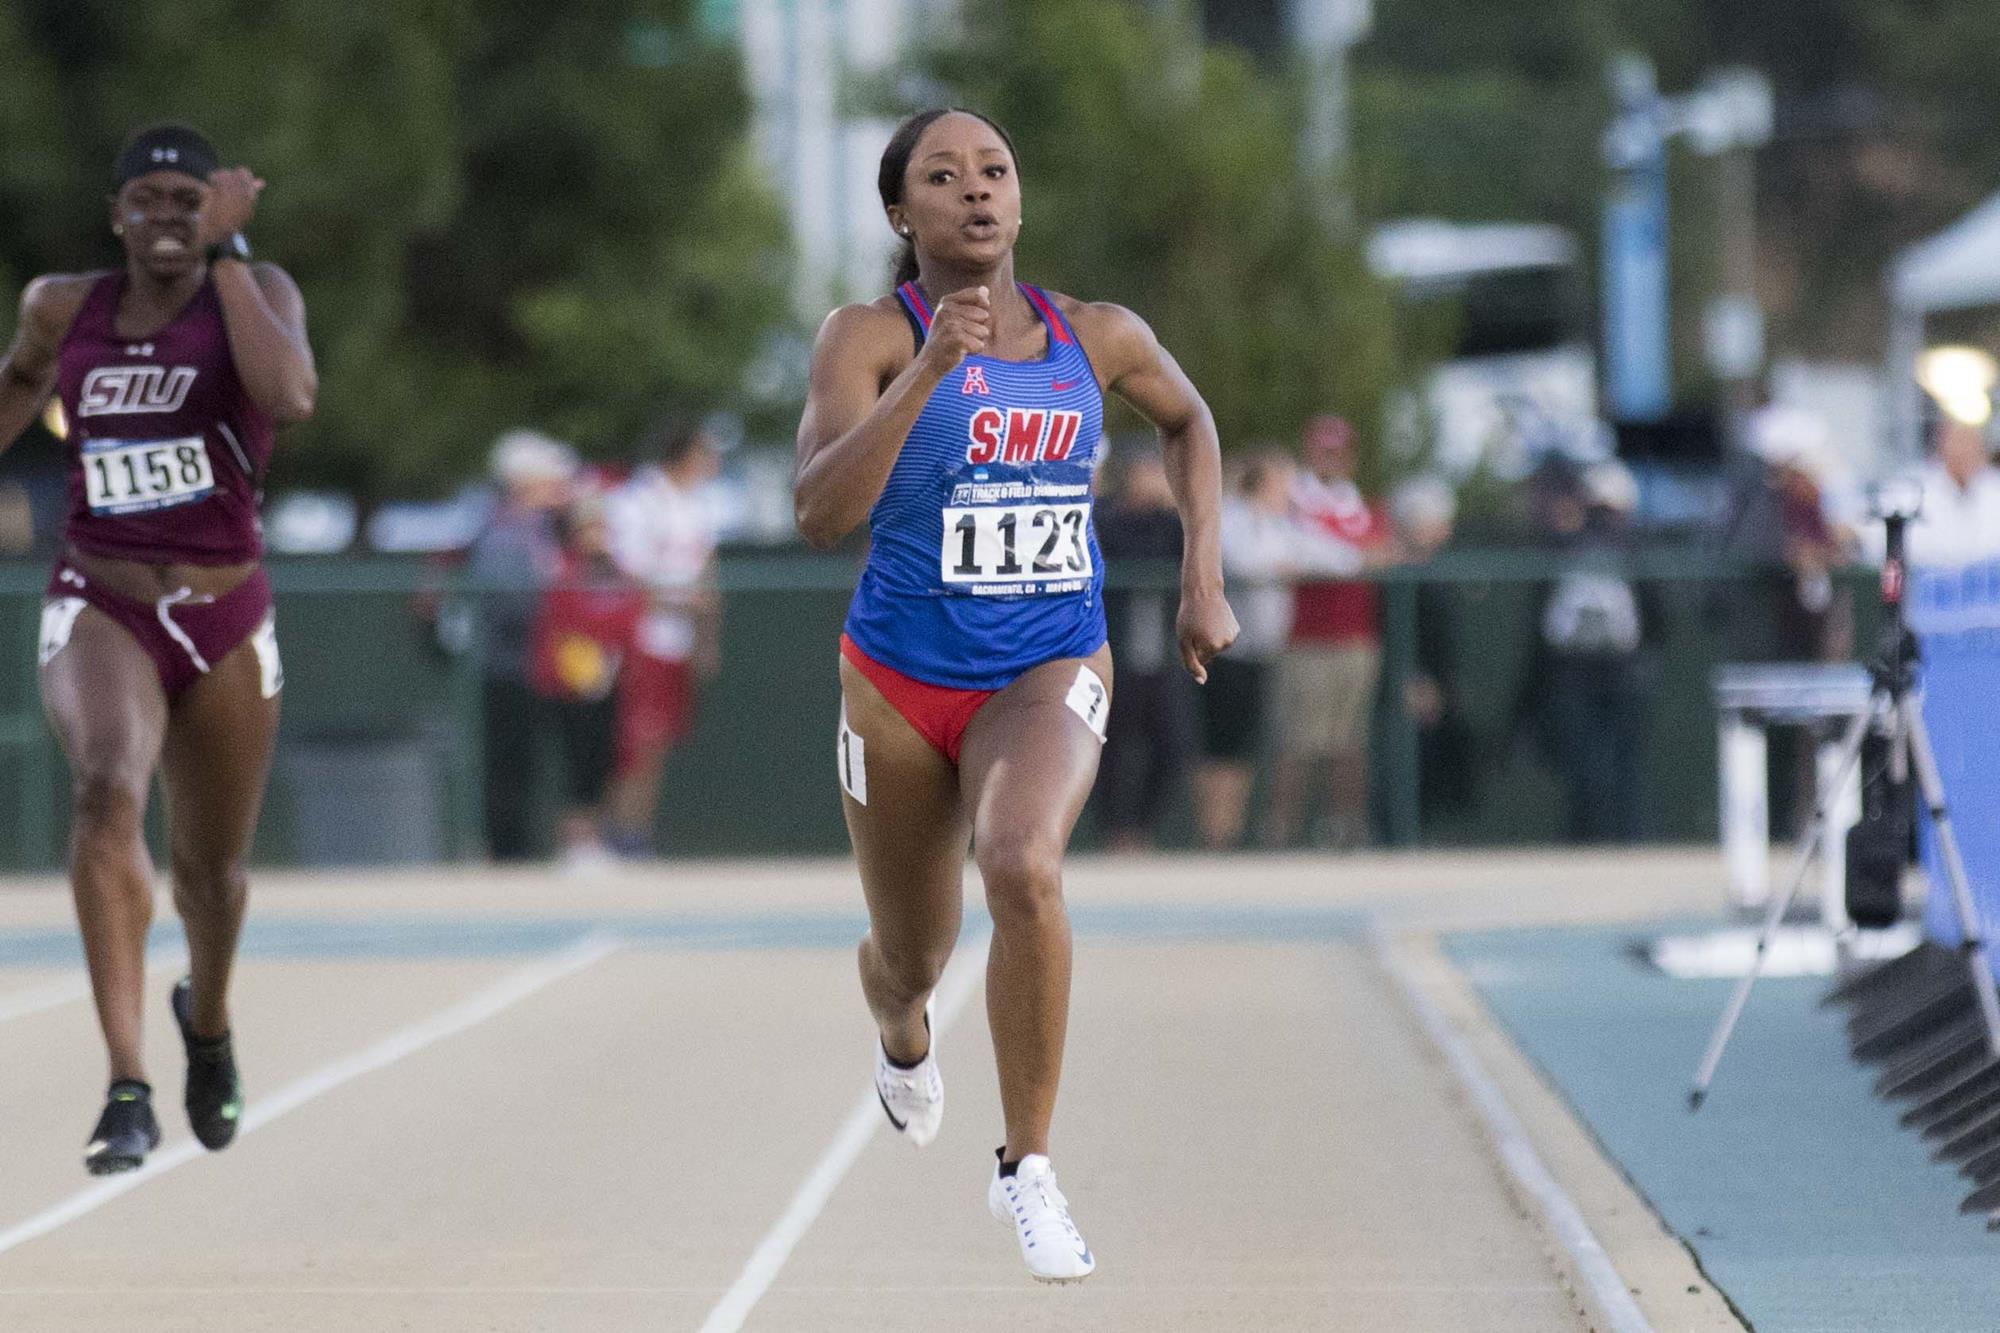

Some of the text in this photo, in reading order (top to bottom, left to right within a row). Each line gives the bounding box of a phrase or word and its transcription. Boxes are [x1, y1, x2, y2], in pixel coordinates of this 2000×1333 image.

[966, 407, 1083, 465] SMU
[95, 446, 202, 498] 1158
[1008, 485, 1033, 498] FIELD
[953, 509, 1087, 575] 1123
